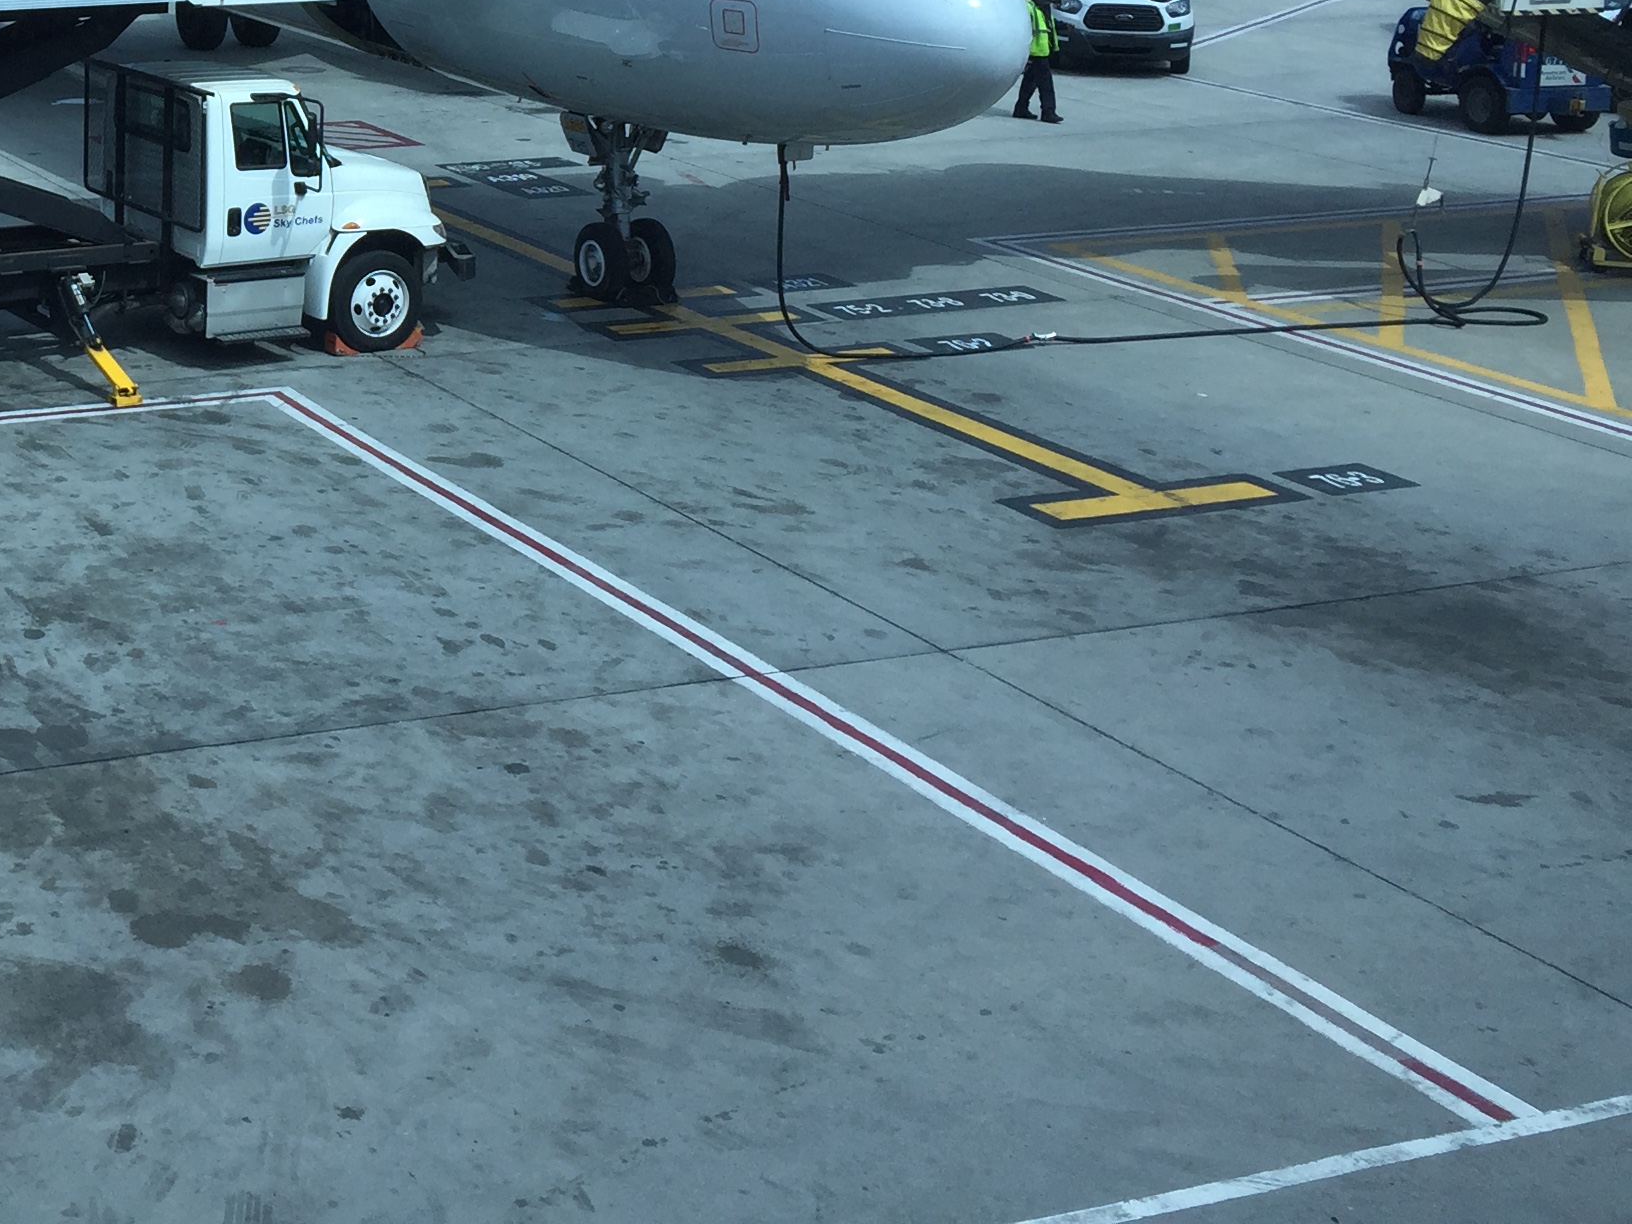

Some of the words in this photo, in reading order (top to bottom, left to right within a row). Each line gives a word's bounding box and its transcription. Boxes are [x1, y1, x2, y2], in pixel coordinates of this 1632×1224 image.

[274, 204, 296, 215] LSG
[273, 217, 293, 228] Sky
[294, 215, 324, 226] Chefs
[1308, 470, 1386, 489] 76-3
